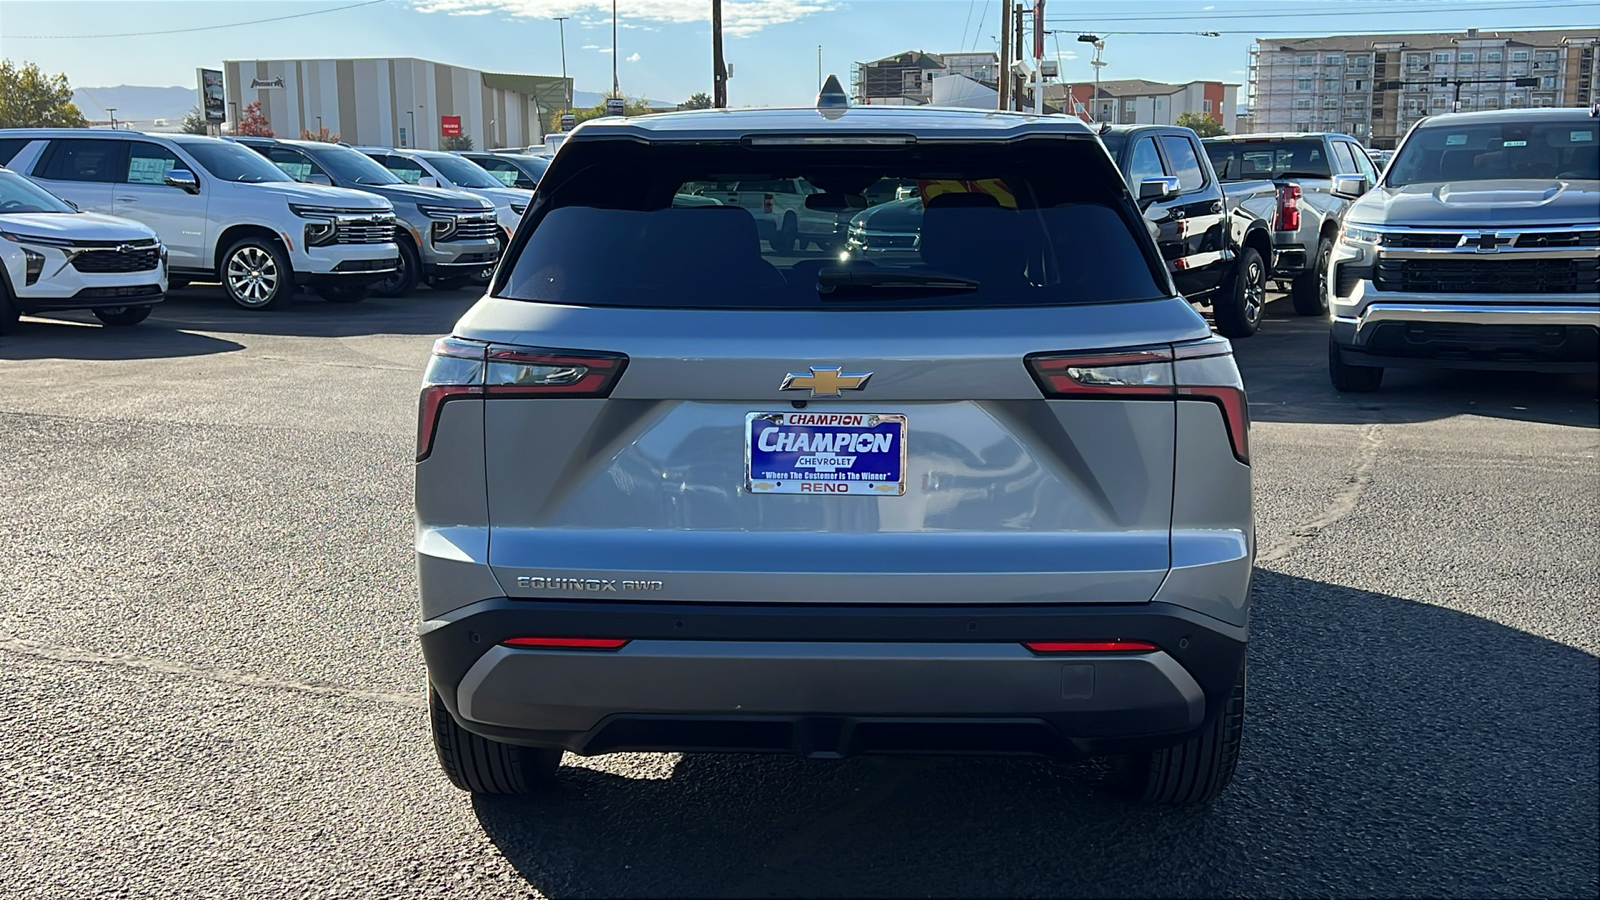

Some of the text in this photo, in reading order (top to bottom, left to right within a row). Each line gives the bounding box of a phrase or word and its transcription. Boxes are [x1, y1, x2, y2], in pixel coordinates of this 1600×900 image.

[789, 414, 863, 426] CHAMPION
[799, 457, 852, 466] CHEVROLET
[790, 472, 803, 480] The
[804, 472, 838, 480] Customer
[839, 472, 846, 480] Is
[847, 472, 860, 480] The
[800, 482, 849, 493] RENO
[517, 576, 663, 592] EQUINOX AWD
